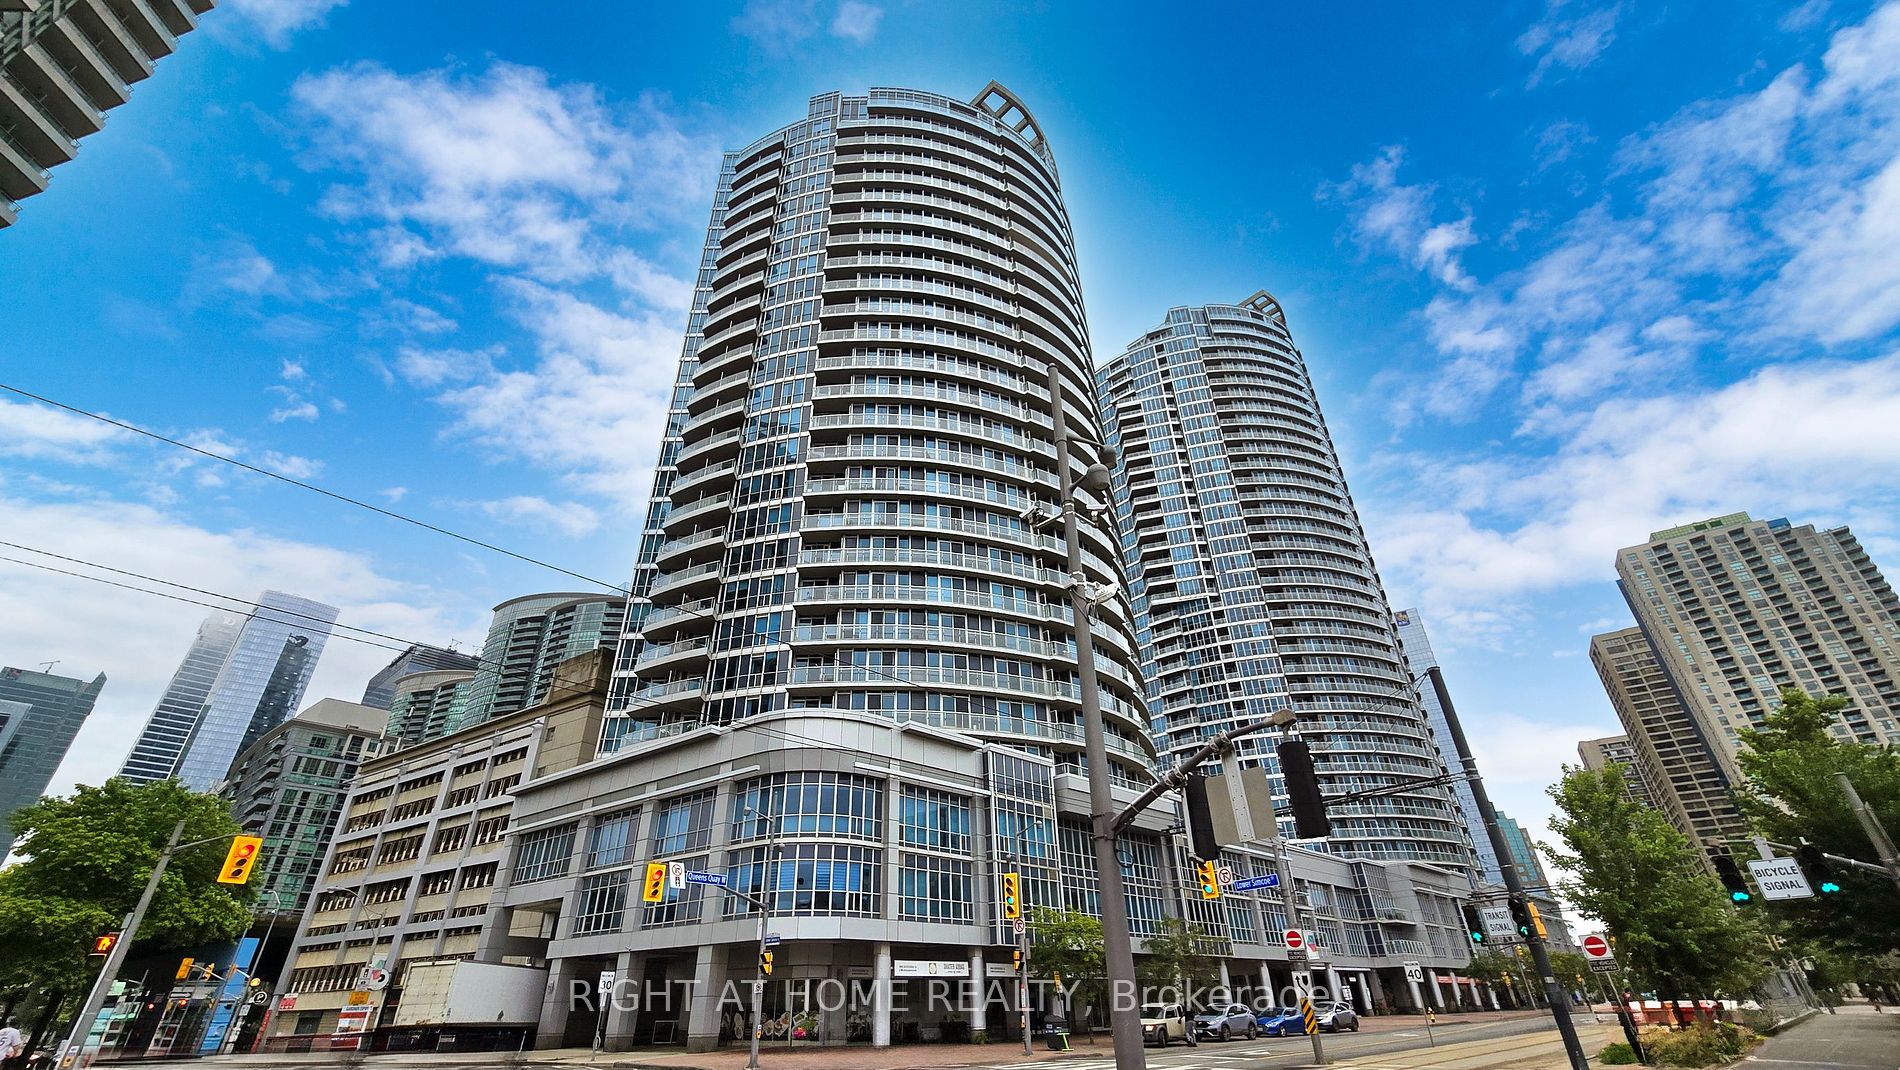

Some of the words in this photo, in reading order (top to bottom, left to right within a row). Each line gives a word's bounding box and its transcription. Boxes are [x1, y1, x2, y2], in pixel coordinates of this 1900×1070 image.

[1754, 865, 1799, 878] BICYCLE
[688, 872, 707, 882] Queens
[708, 873, 721, 884] Quay
[1236, 881, 1251, 890] Lower
[1252, 877, 1271, 887] Simcoe
[1763, 879, 1804, 891] SIGNAL
[1484, 910, 1509, 920] TRANSIT
[1489, 922, 1512, 932] SIGNAL
[1407, 968, 1421, 980] 40
[600, 980, 612, 990] 30
